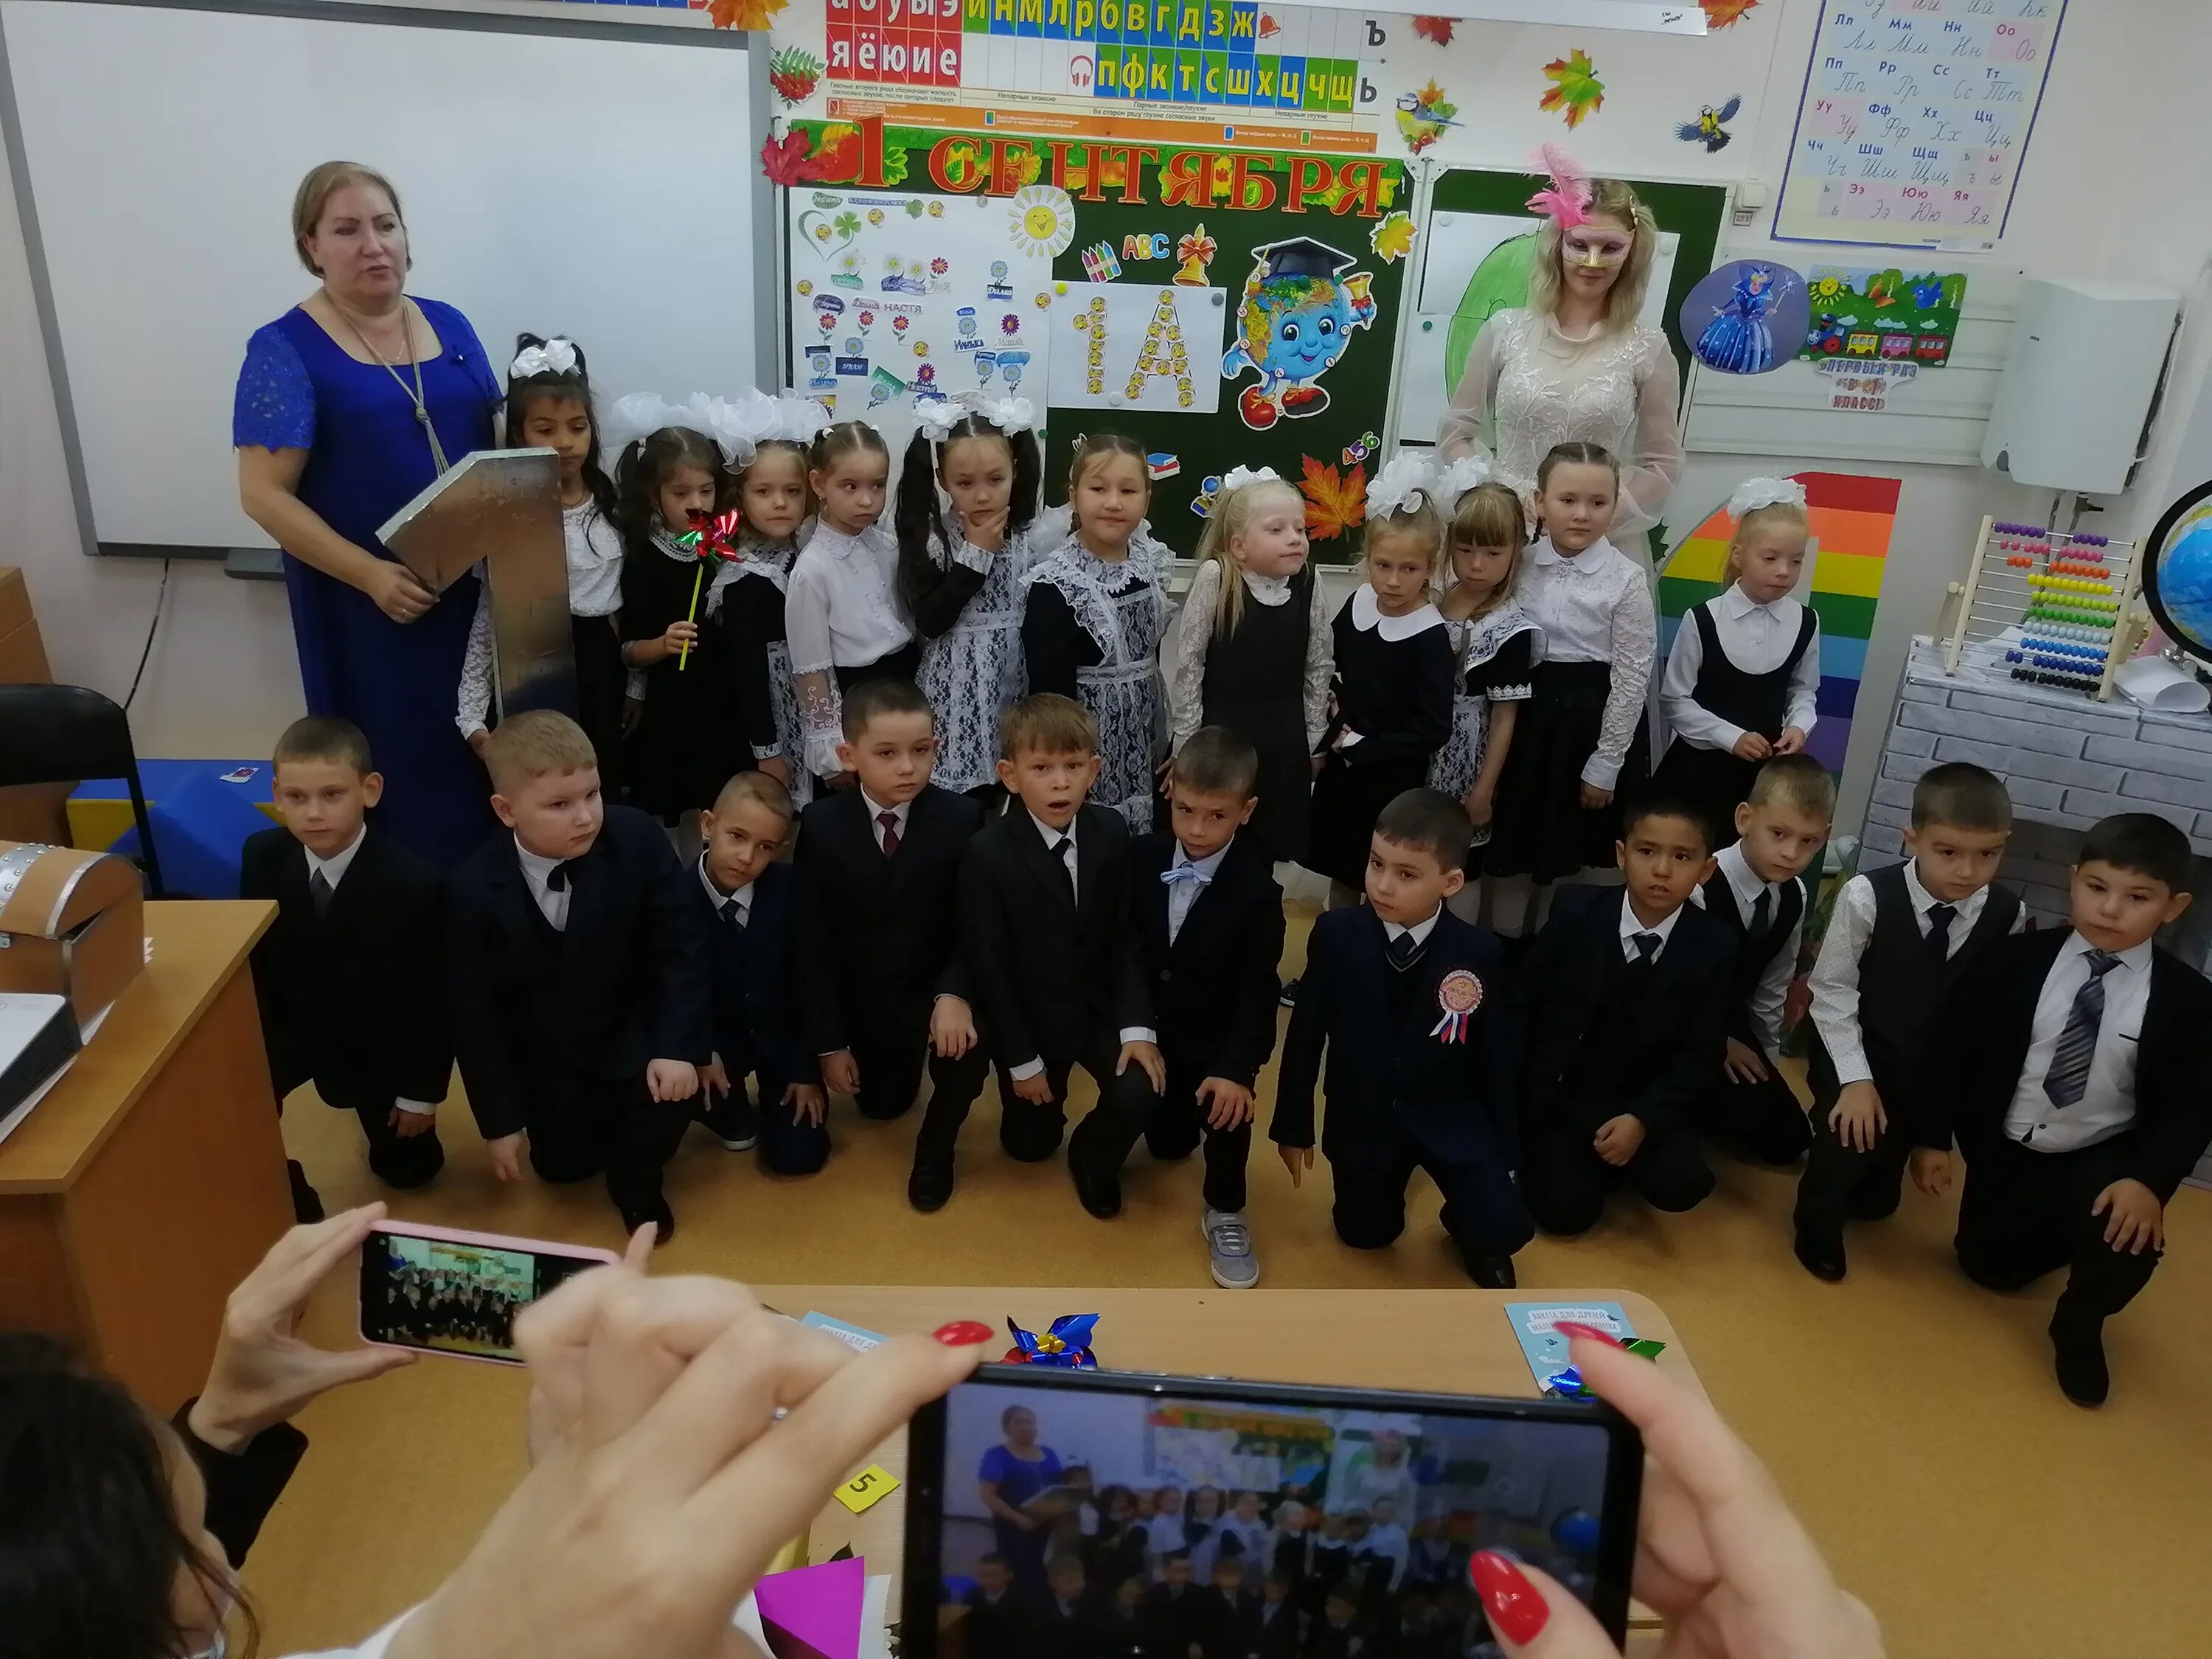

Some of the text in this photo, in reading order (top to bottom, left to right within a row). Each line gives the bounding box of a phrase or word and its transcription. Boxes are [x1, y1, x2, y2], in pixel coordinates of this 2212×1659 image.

[1888, 18, 1913, 30] Мм
[1944, 21, 1962, 32] Нн
[1825, 58, 1843, 69] Пп
[928, 135, 1388, 219] СЕНТЯБРЯ
[1121, 233, 1171, 261] ABC
[885, 303, 922, 314] НАСТЯ
[849, 1473, 877, 1493] 5
